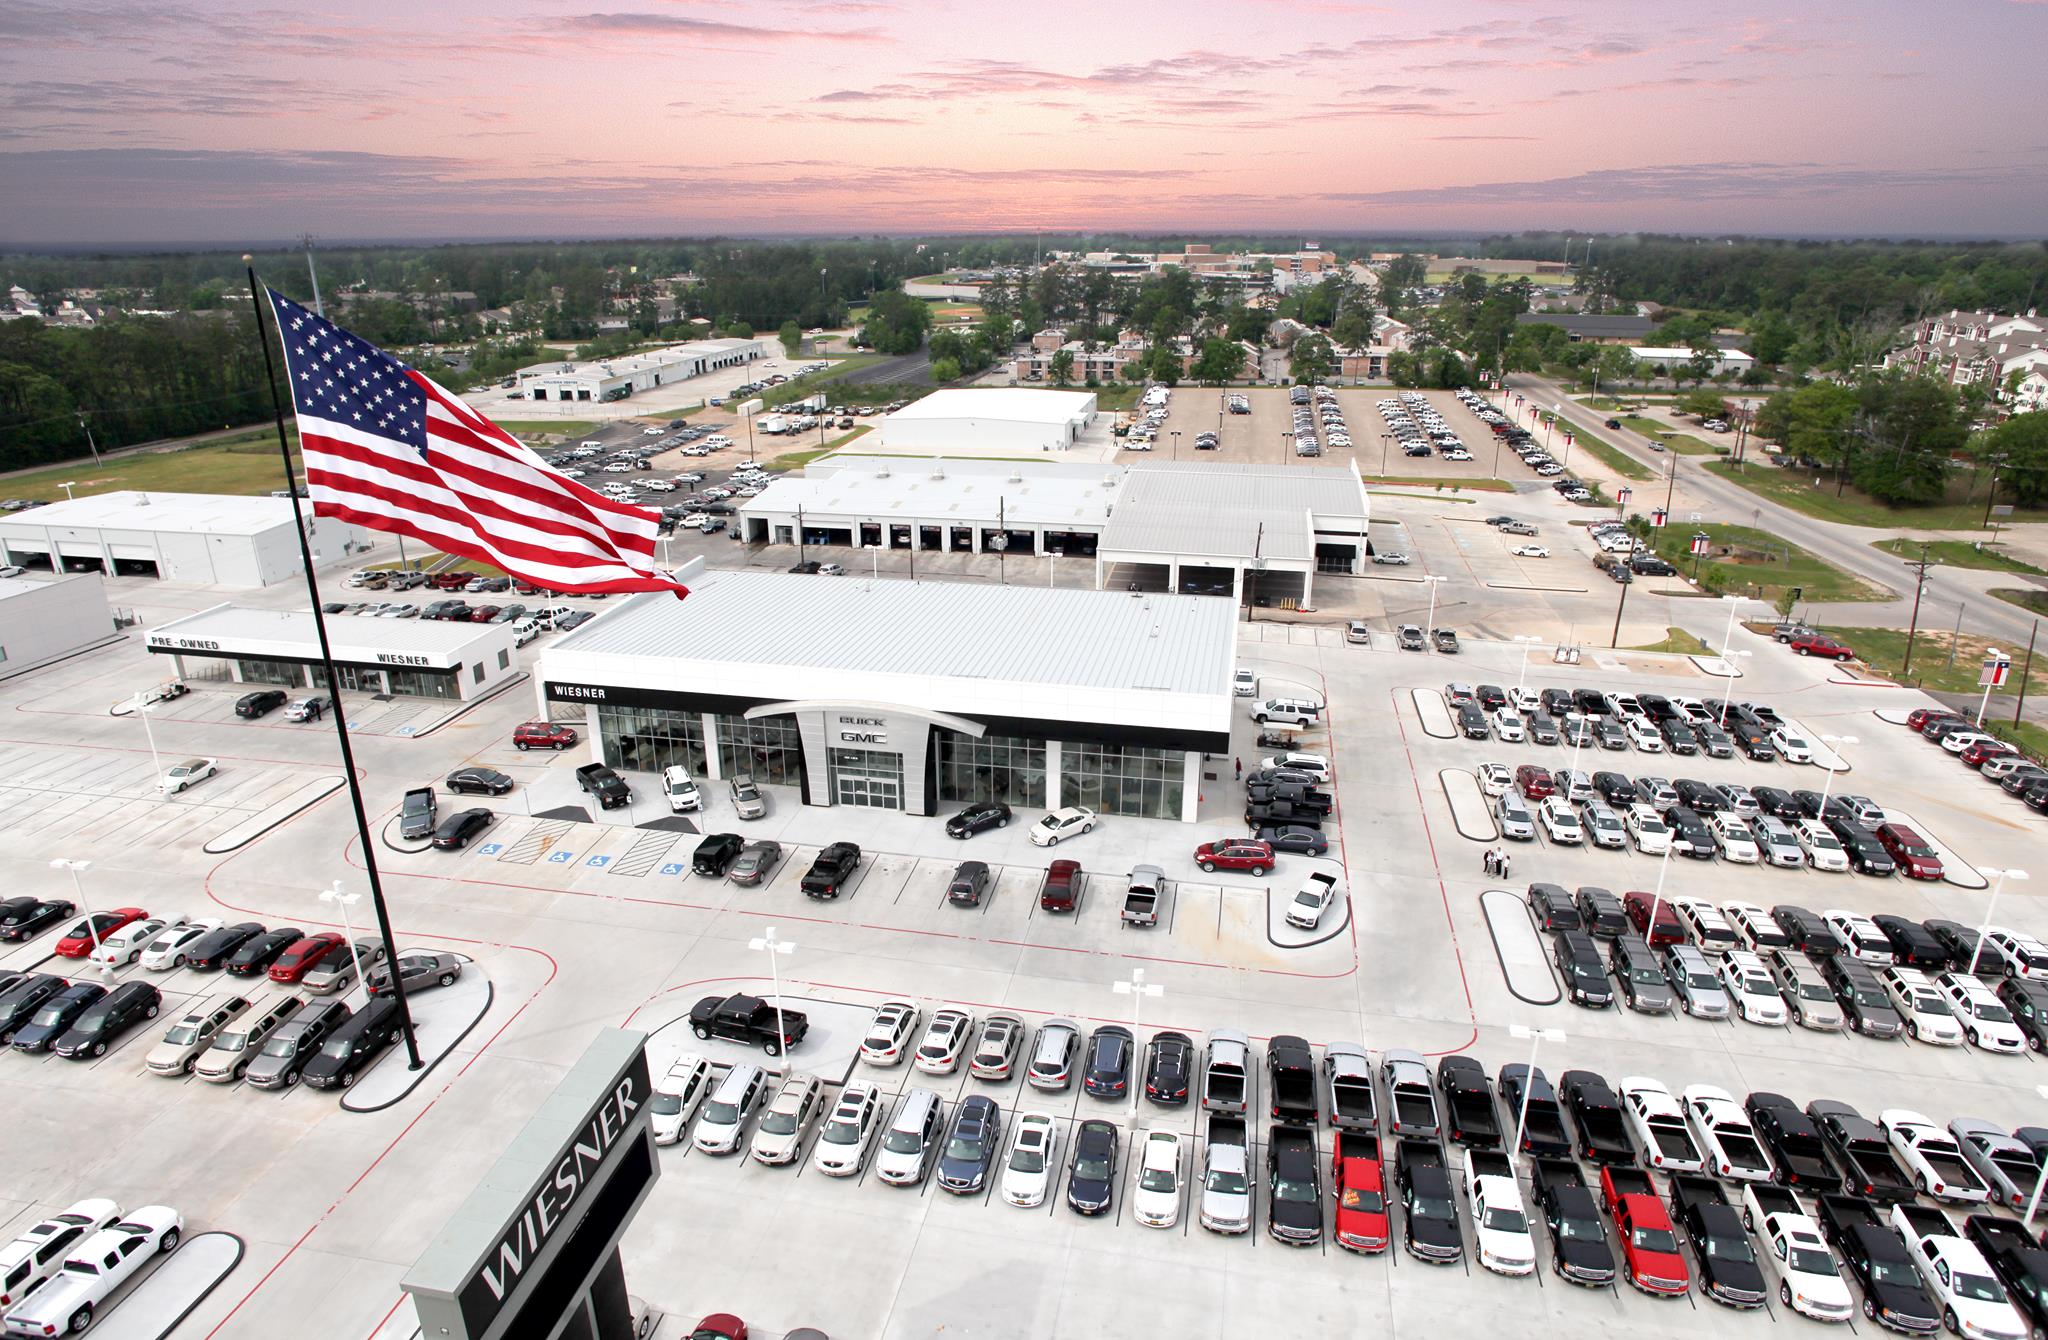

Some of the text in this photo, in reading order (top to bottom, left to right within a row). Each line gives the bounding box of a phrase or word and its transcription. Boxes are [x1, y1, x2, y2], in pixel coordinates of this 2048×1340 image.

[151, 636, 219, 650] PRE-OWNED
[376, 653, 430, 666] WIESNER
[554, 685, 606, 699] WIESNER
[839, 716, 886, 726] BUICK
[840, 731, 887, 744] GMC
[481, 1077, 638, 1301] WIESNER
